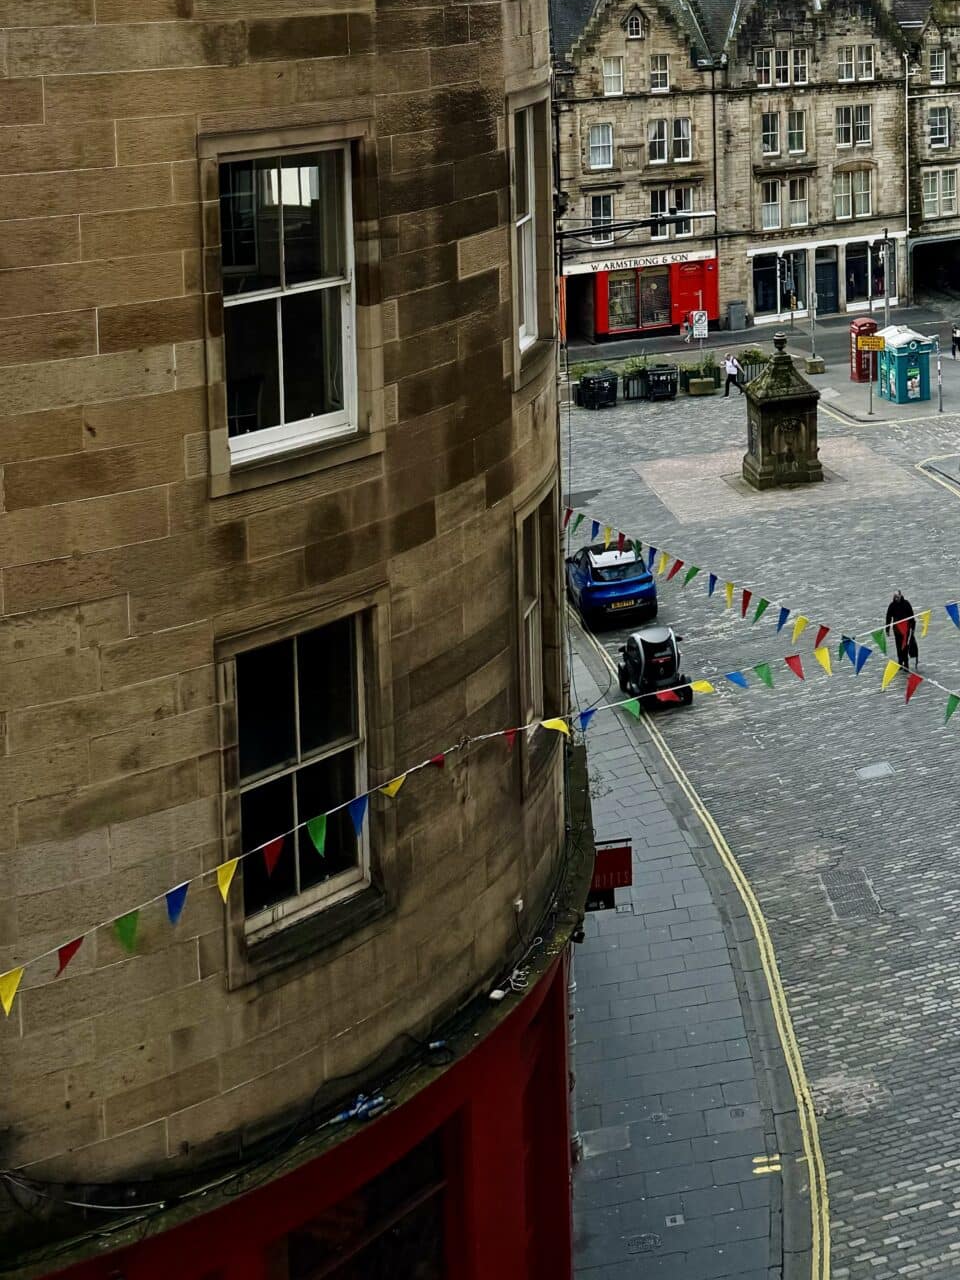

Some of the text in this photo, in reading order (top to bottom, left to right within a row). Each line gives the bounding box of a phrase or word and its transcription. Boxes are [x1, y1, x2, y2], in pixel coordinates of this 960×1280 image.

[603, 257, 659, 270] ARMSTRONG
[662, 256, 668, 264] &
[671, 254, 689, 262] SON
